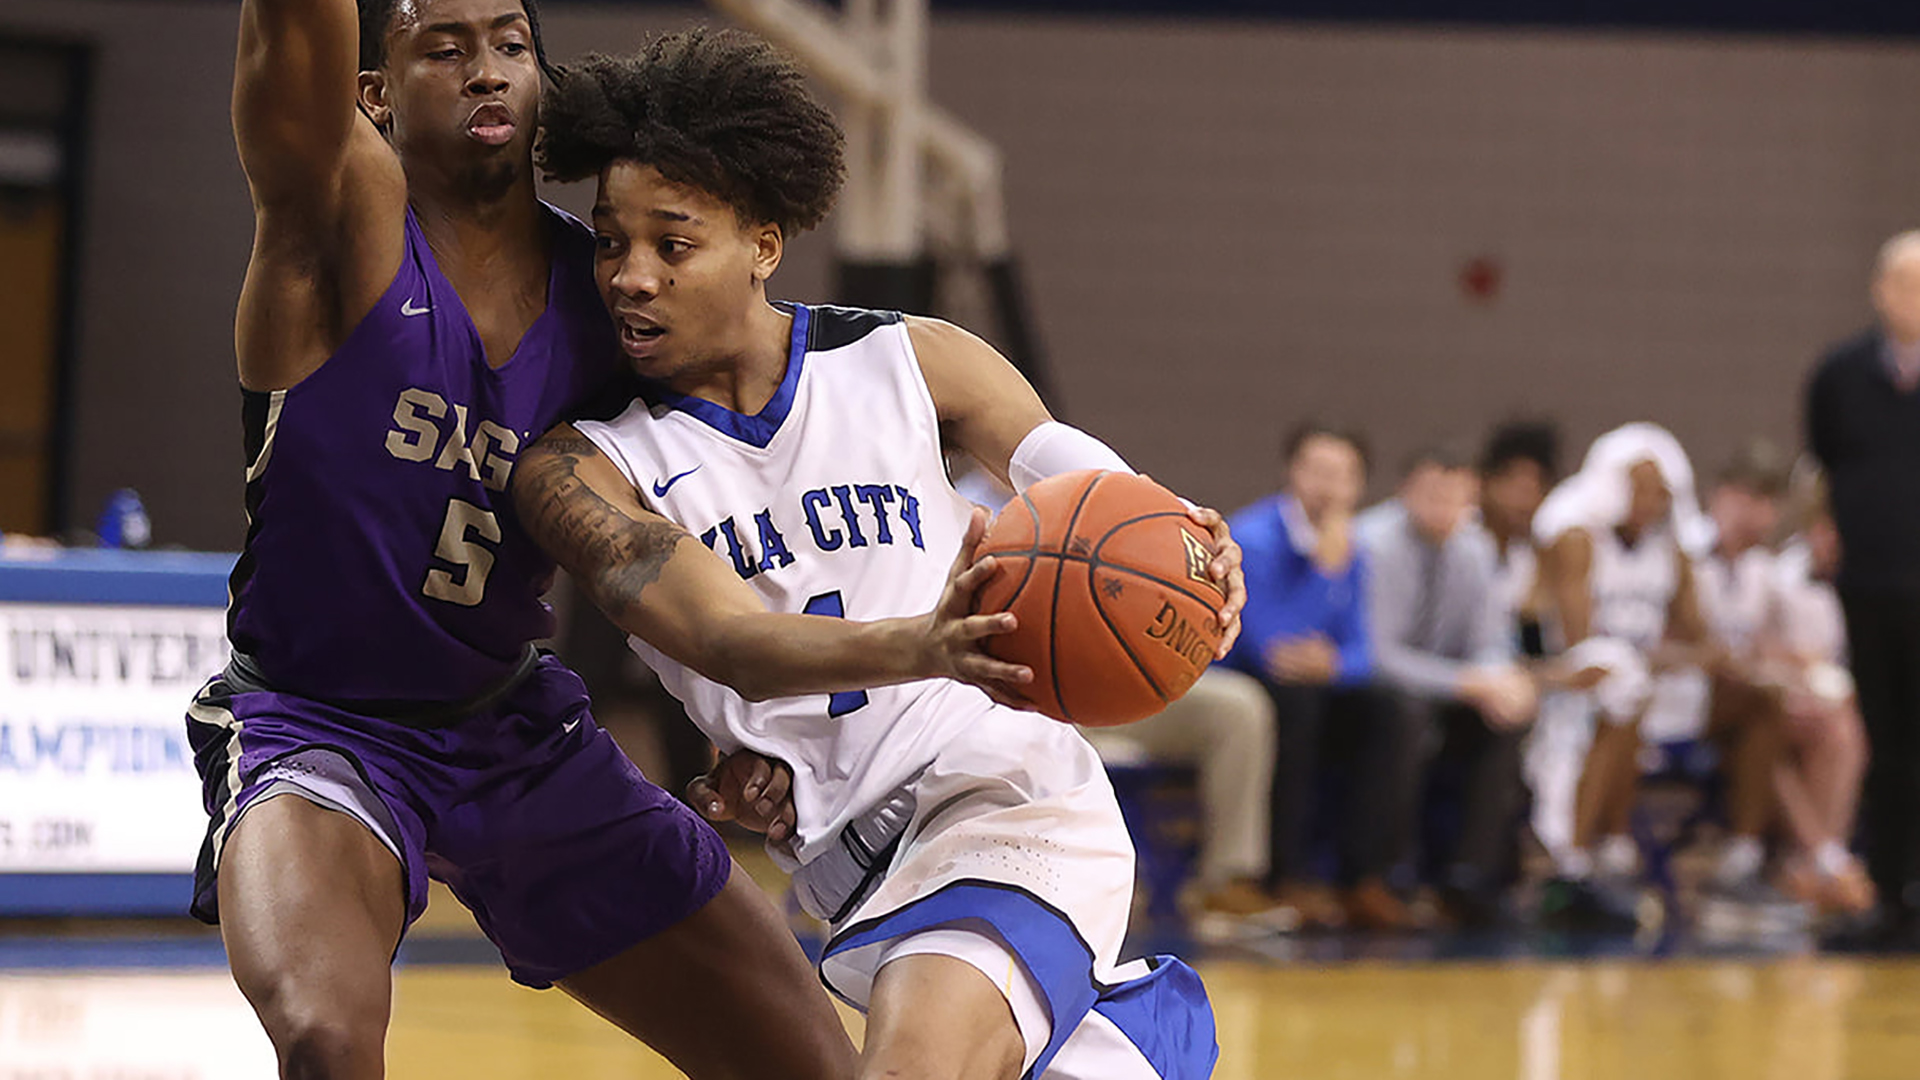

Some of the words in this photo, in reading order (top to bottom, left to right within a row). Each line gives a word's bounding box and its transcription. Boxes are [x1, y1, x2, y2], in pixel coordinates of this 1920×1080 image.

[384, 387, 530, 492] SAG
[423, 499, 501, 606] 5
[802, 484, 926, 551] CITY
